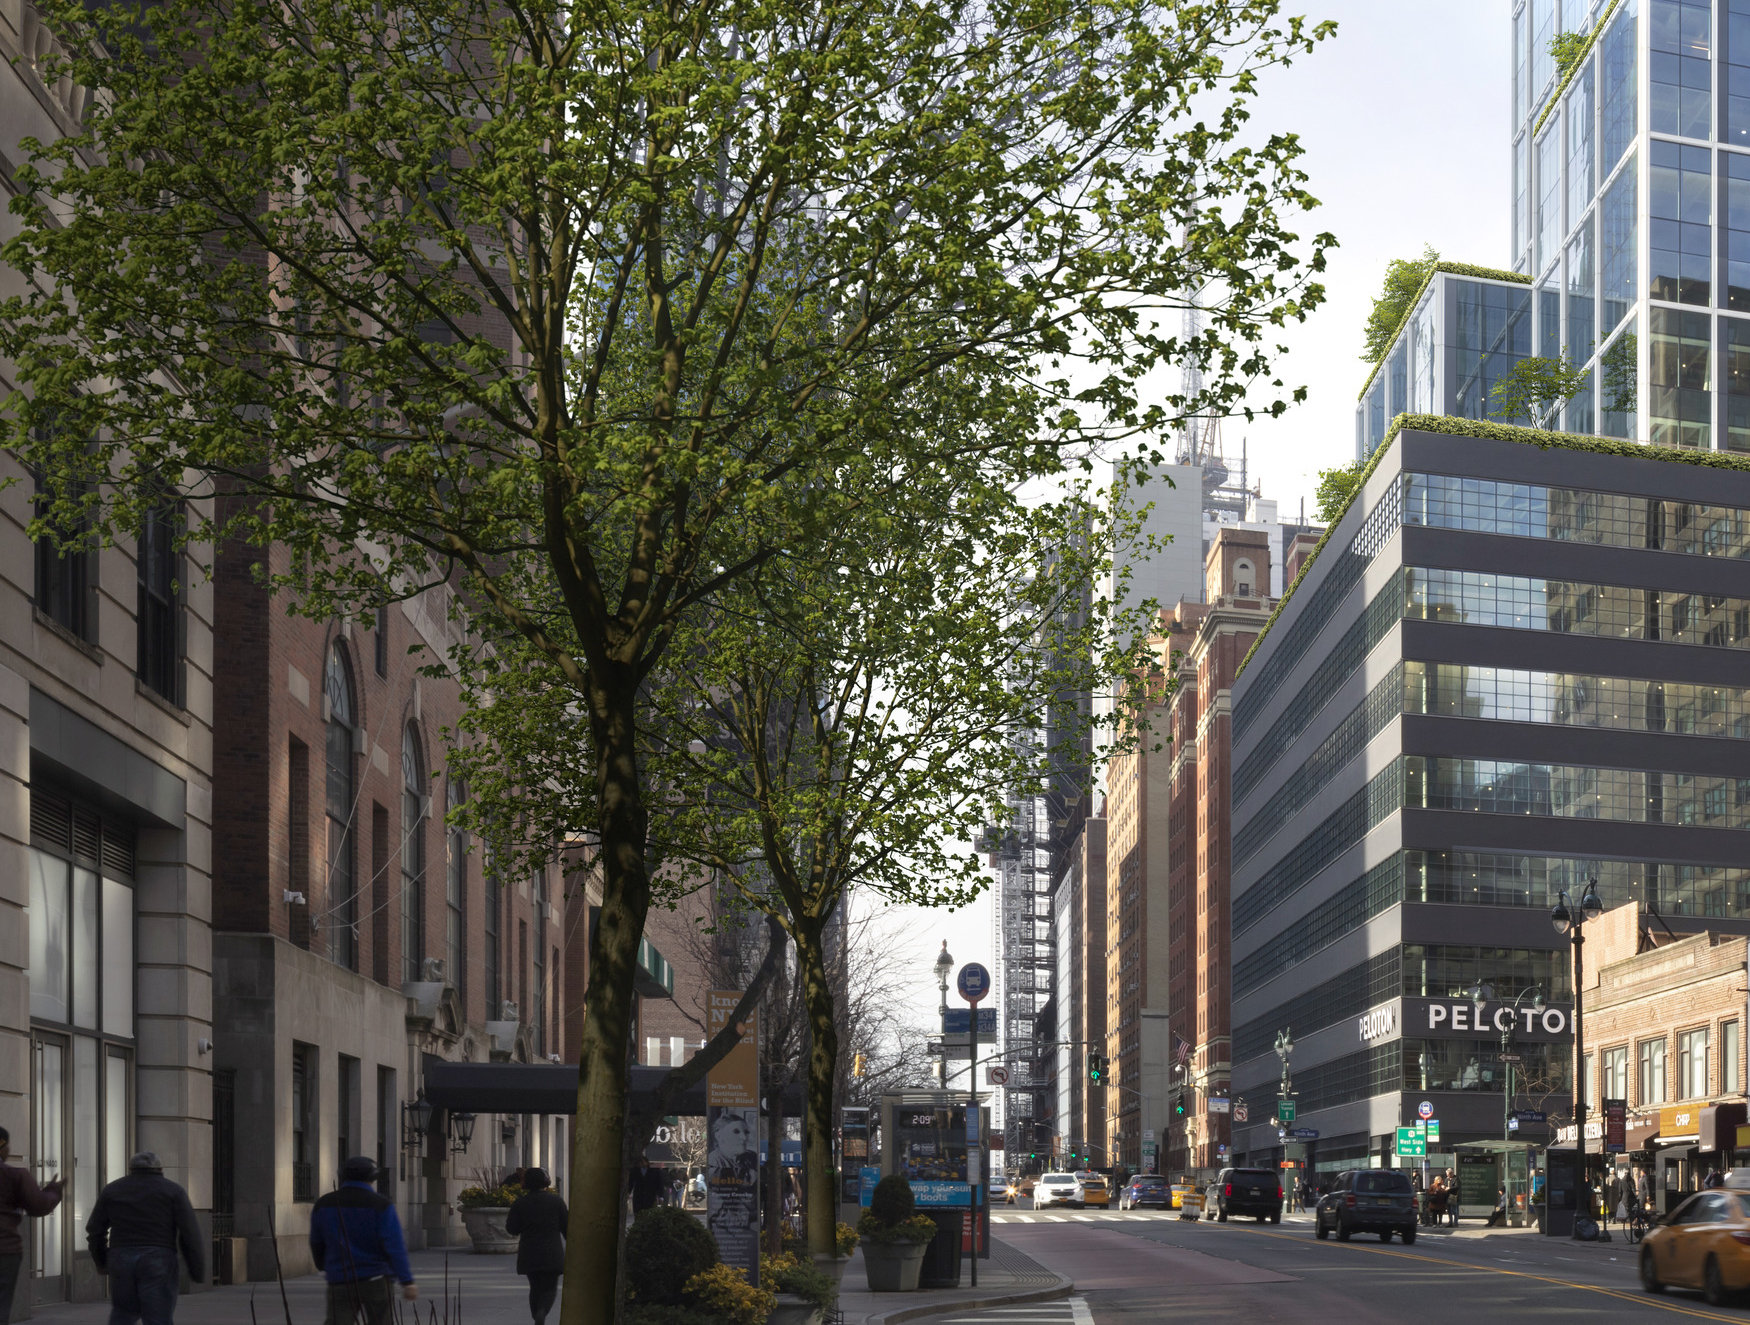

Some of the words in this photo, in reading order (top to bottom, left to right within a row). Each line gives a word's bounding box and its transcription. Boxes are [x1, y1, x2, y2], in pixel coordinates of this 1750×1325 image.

[978, 1011, 993, 1020] M34
[1429, 1004, 1575, 1034] PELOTO
[1359, 1006, 1394, 1041] PELOTON
[912, 1115, 931, 1124] 2:09
[909, 1183, 929, 1193] wap
[931, 1184, 953, 1195] your
[920, 1193, 948, 1202] boots
